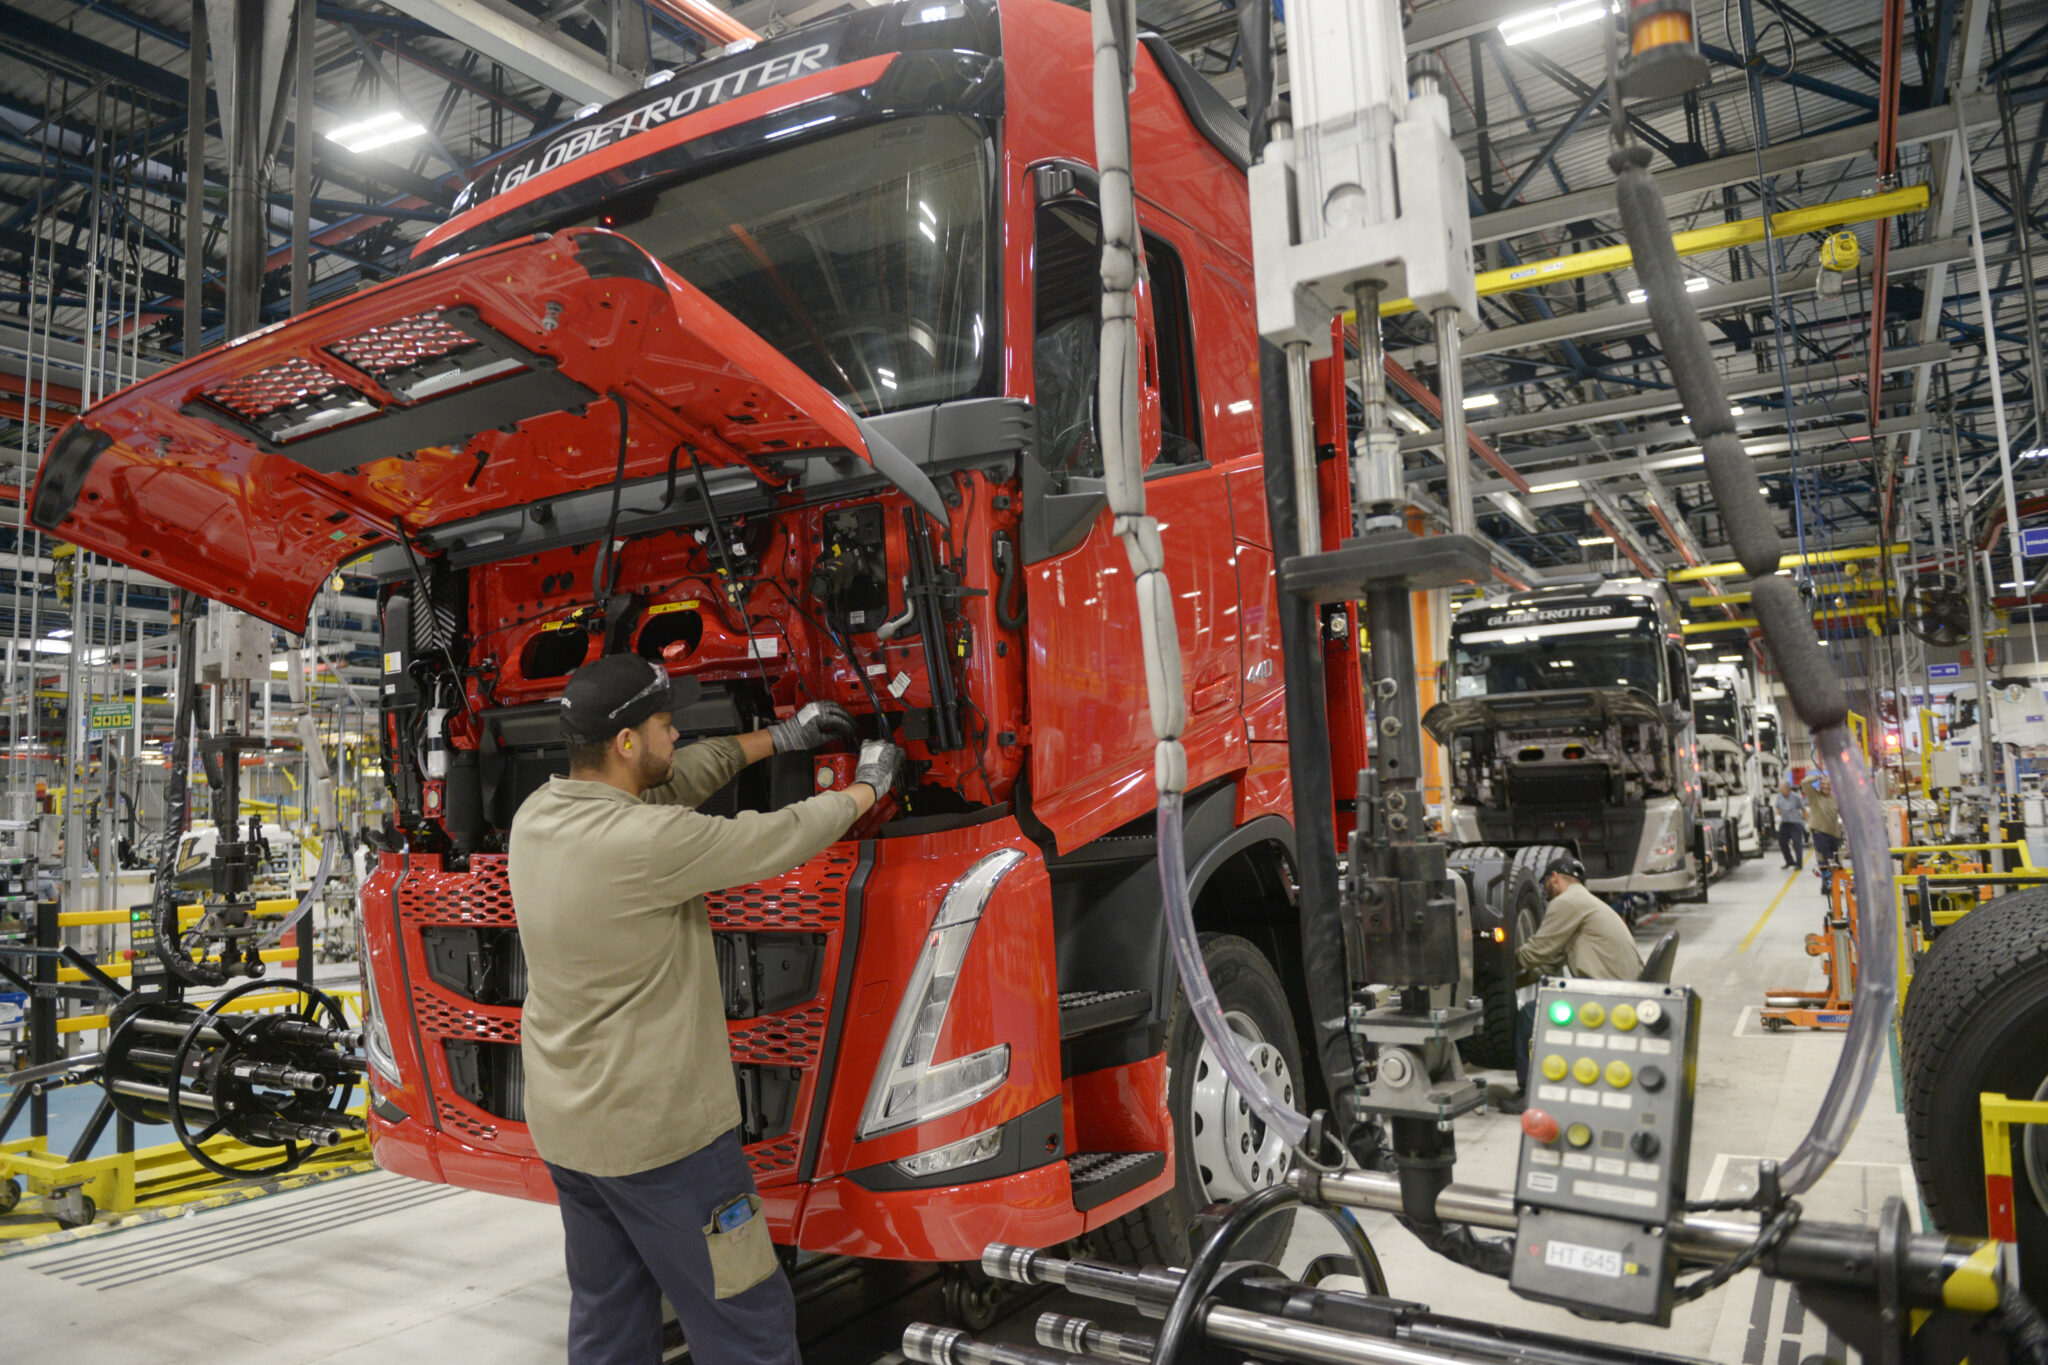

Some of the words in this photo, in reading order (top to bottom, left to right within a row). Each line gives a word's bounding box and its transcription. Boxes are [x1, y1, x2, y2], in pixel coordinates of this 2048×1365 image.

[499, 43, 830, 195] GLOBETROTTER
[1487, 606, 1612, 627] GLOBETROTTER
[1247, 659, 1272, 684] 440
[1550, 1246, 1577, 1264] HT
[1582, 1250, 1617, 1272] 645
